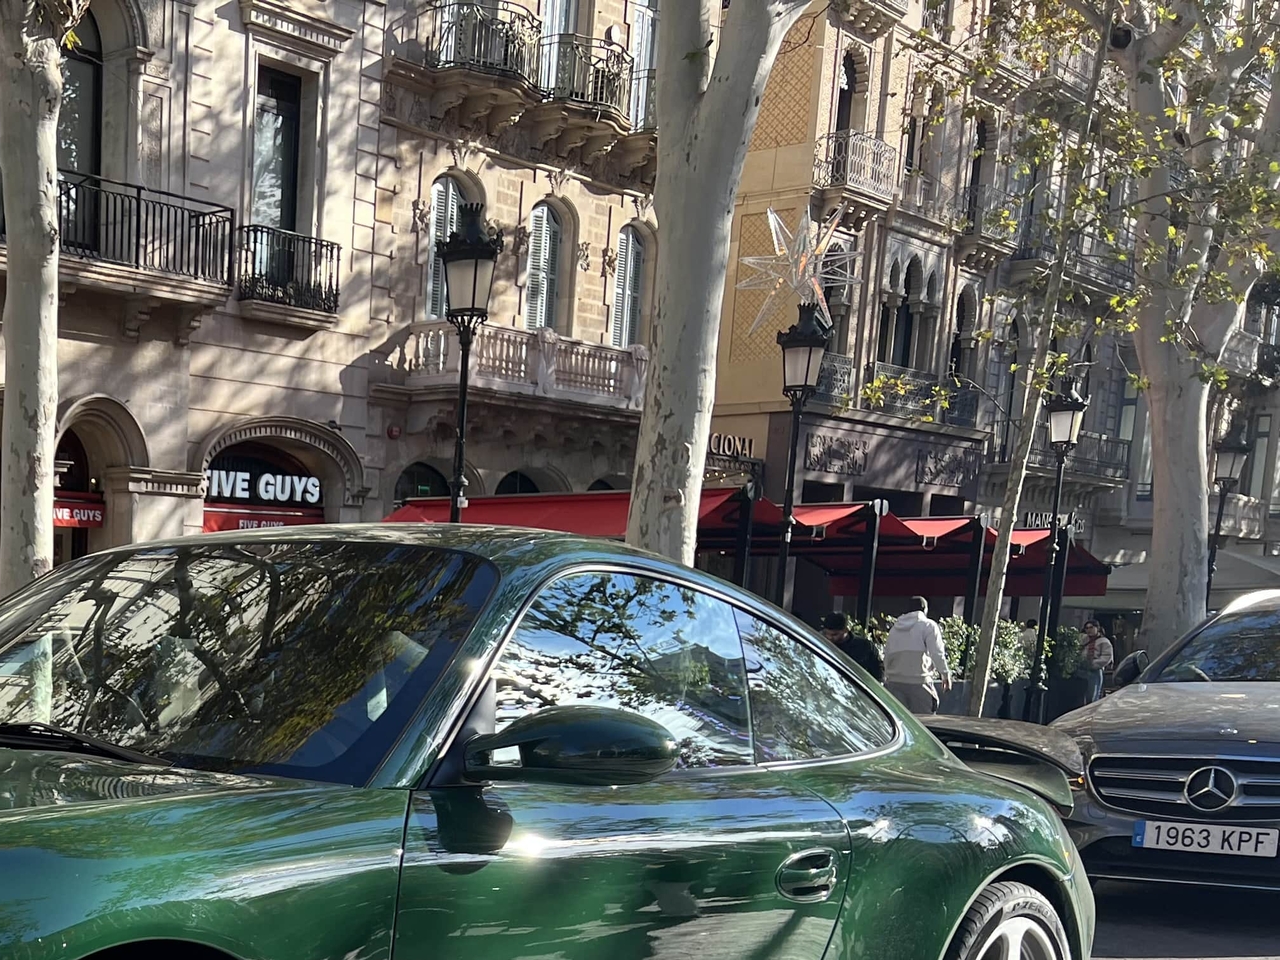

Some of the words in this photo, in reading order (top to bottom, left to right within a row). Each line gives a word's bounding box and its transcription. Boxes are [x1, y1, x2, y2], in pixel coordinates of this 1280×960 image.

[707, 432, 755, 458] CIONAL
[258, 473, 320, 503] GUYS
[53, 507, 70, 520] IVE
[73, 509, 102, 521] GUYS
[1154, 825, 1211, 849] 1963
[1220, 830, 1270, 853] KPF
